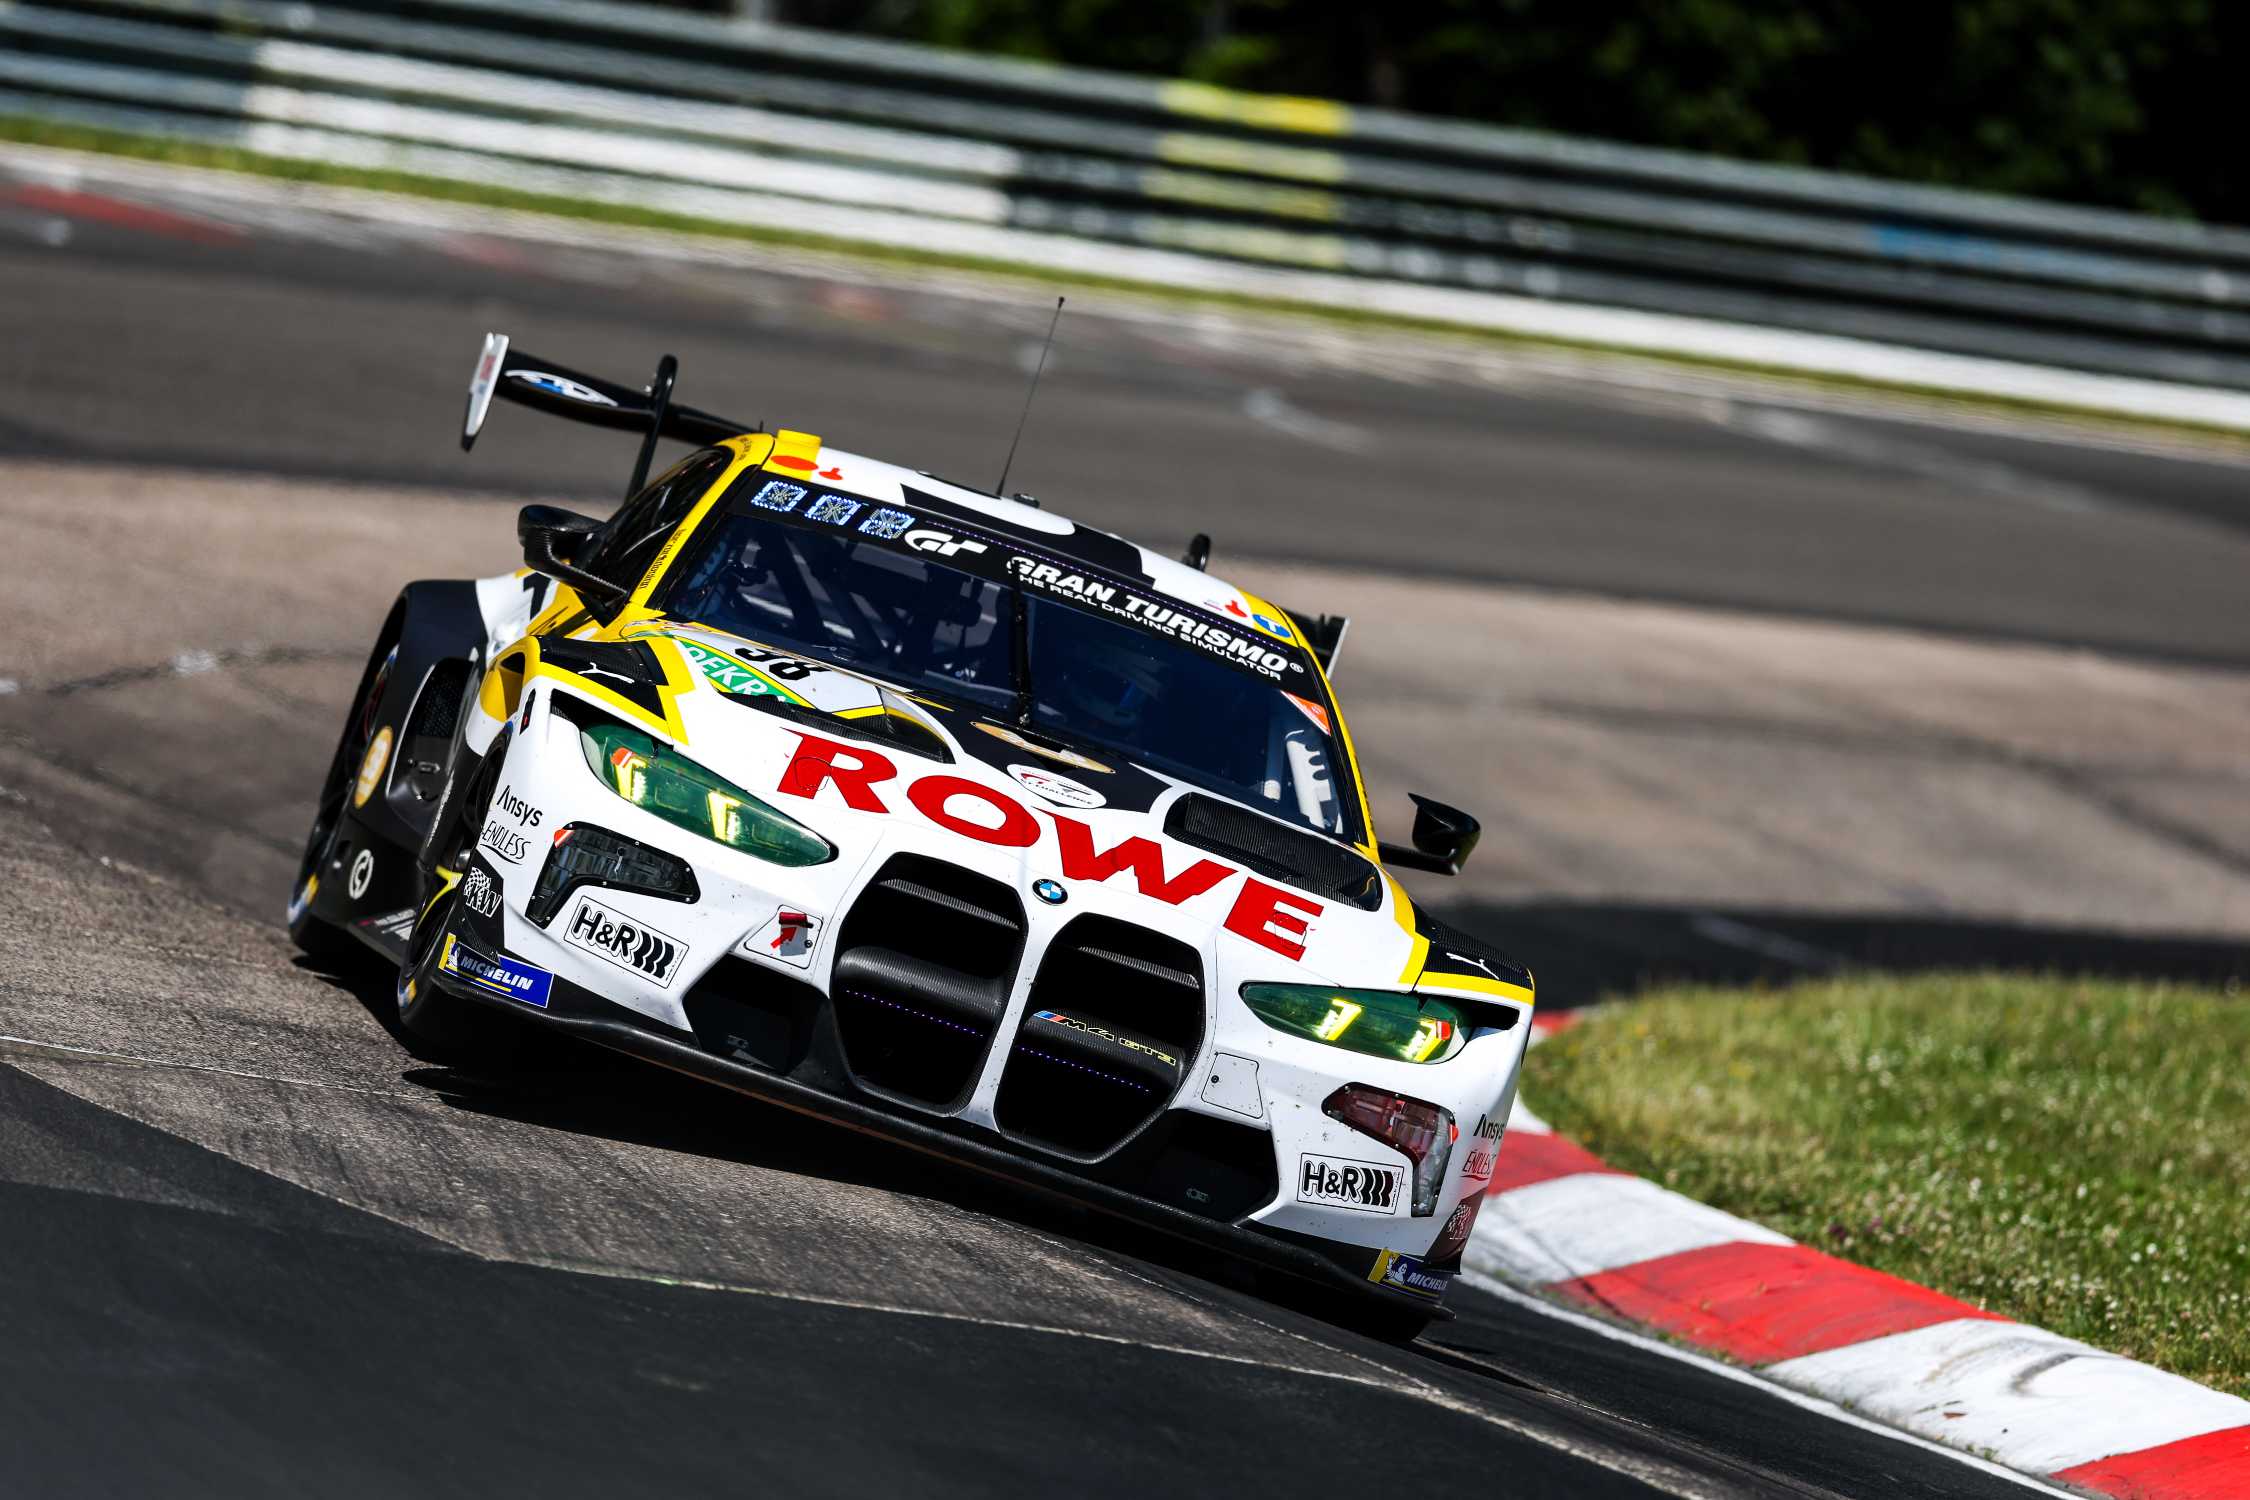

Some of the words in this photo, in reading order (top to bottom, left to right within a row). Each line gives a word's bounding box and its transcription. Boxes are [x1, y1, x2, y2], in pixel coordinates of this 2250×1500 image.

[1006, 556, 1116, 602] GRAN
[1008, 570, 1045, 589] HE
[1050, 584, 1097, 607] REAL
[1102, 603, 1175, 637] DRIVING
[1179, 632, 1282, 681] SIMULATOR
[687, 646, 786, 703] DEKR
[496, 785, 543, 827] Ansys
[481, 820, 531, 860] ENDLESS
[777, 727, 1324, 962] ROWE
[465, 882, 502, 918] KW
[571, 903, 641, 962] H&R
[460, 955, 534, 991] MICHELIN
[1302, 1160, 1362, 1203] H&R
